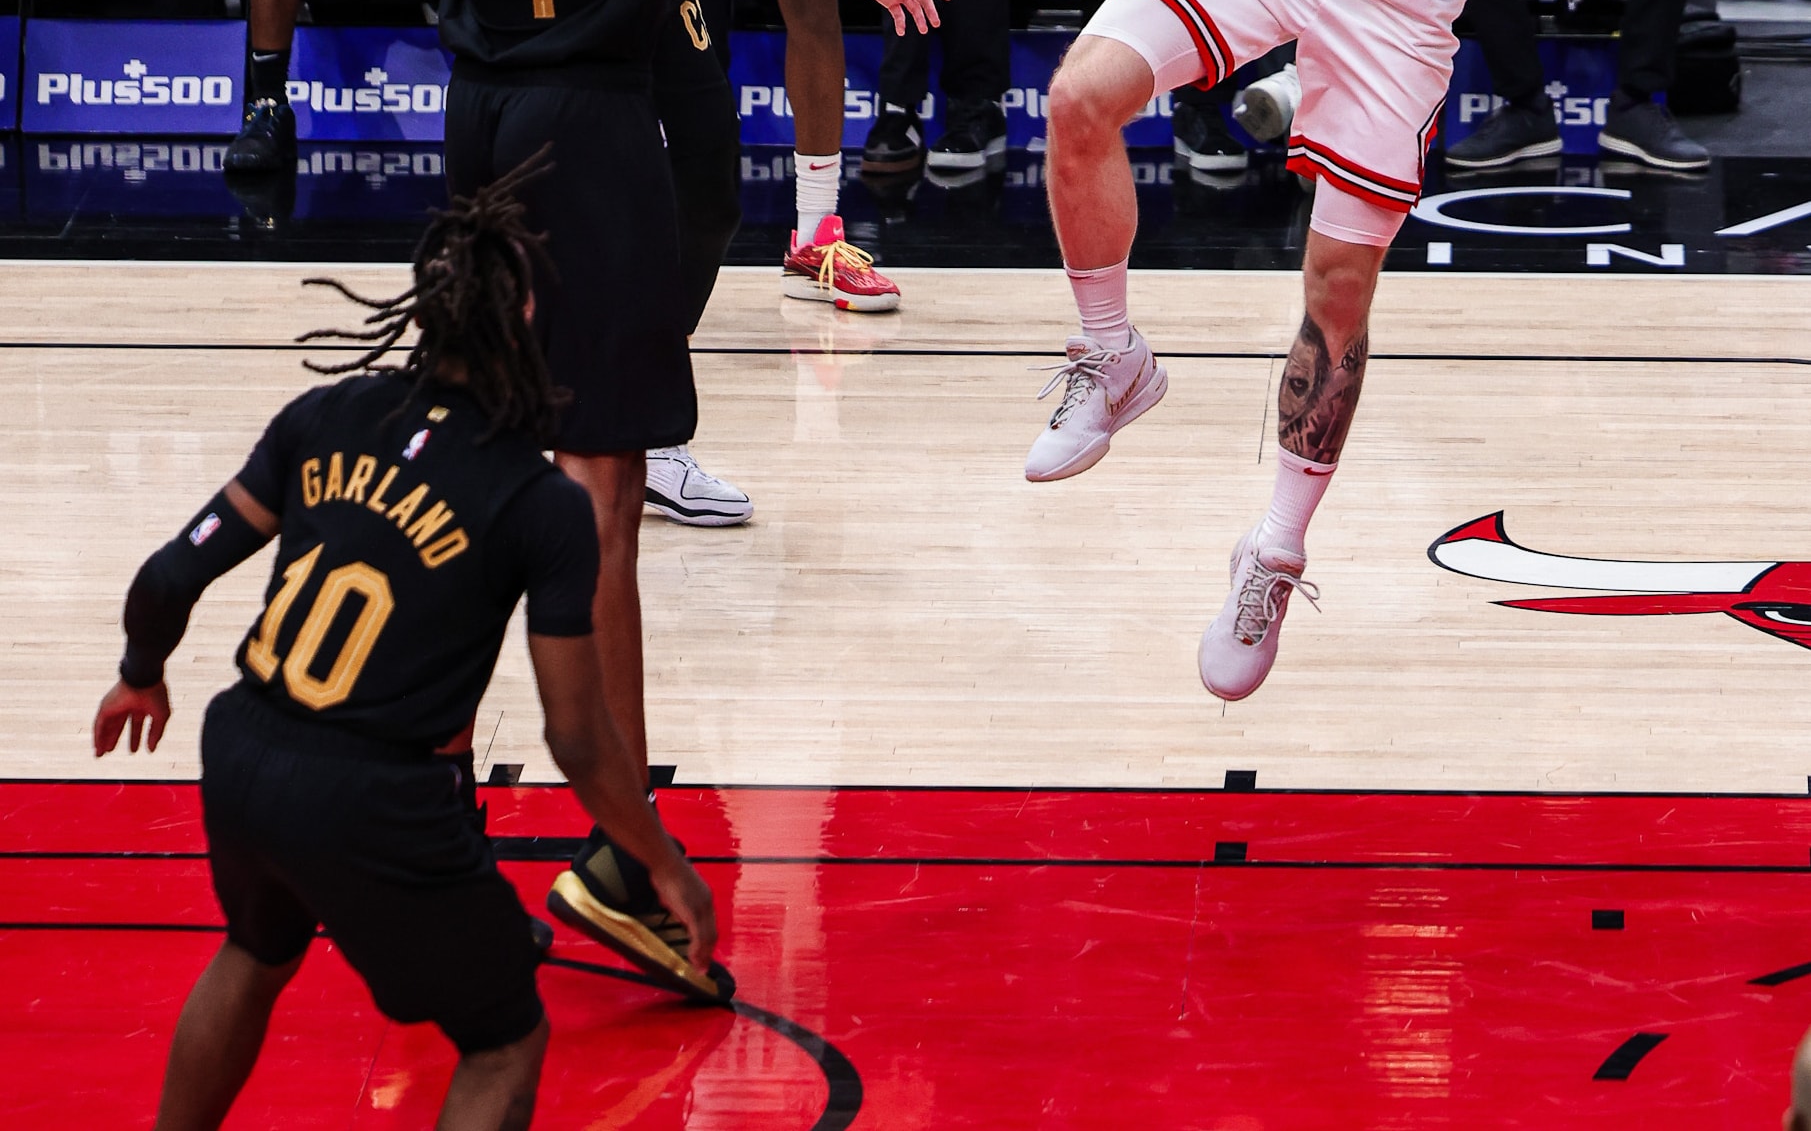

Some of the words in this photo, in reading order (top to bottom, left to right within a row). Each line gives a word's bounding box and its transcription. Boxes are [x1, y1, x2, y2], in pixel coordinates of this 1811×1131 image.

[37, 73, 233, 106] Plus500
[285, 80, 446, 112] Plus50
[301, 451, 470, 570] GARLAND
[245, 542, 396, 712] 10
